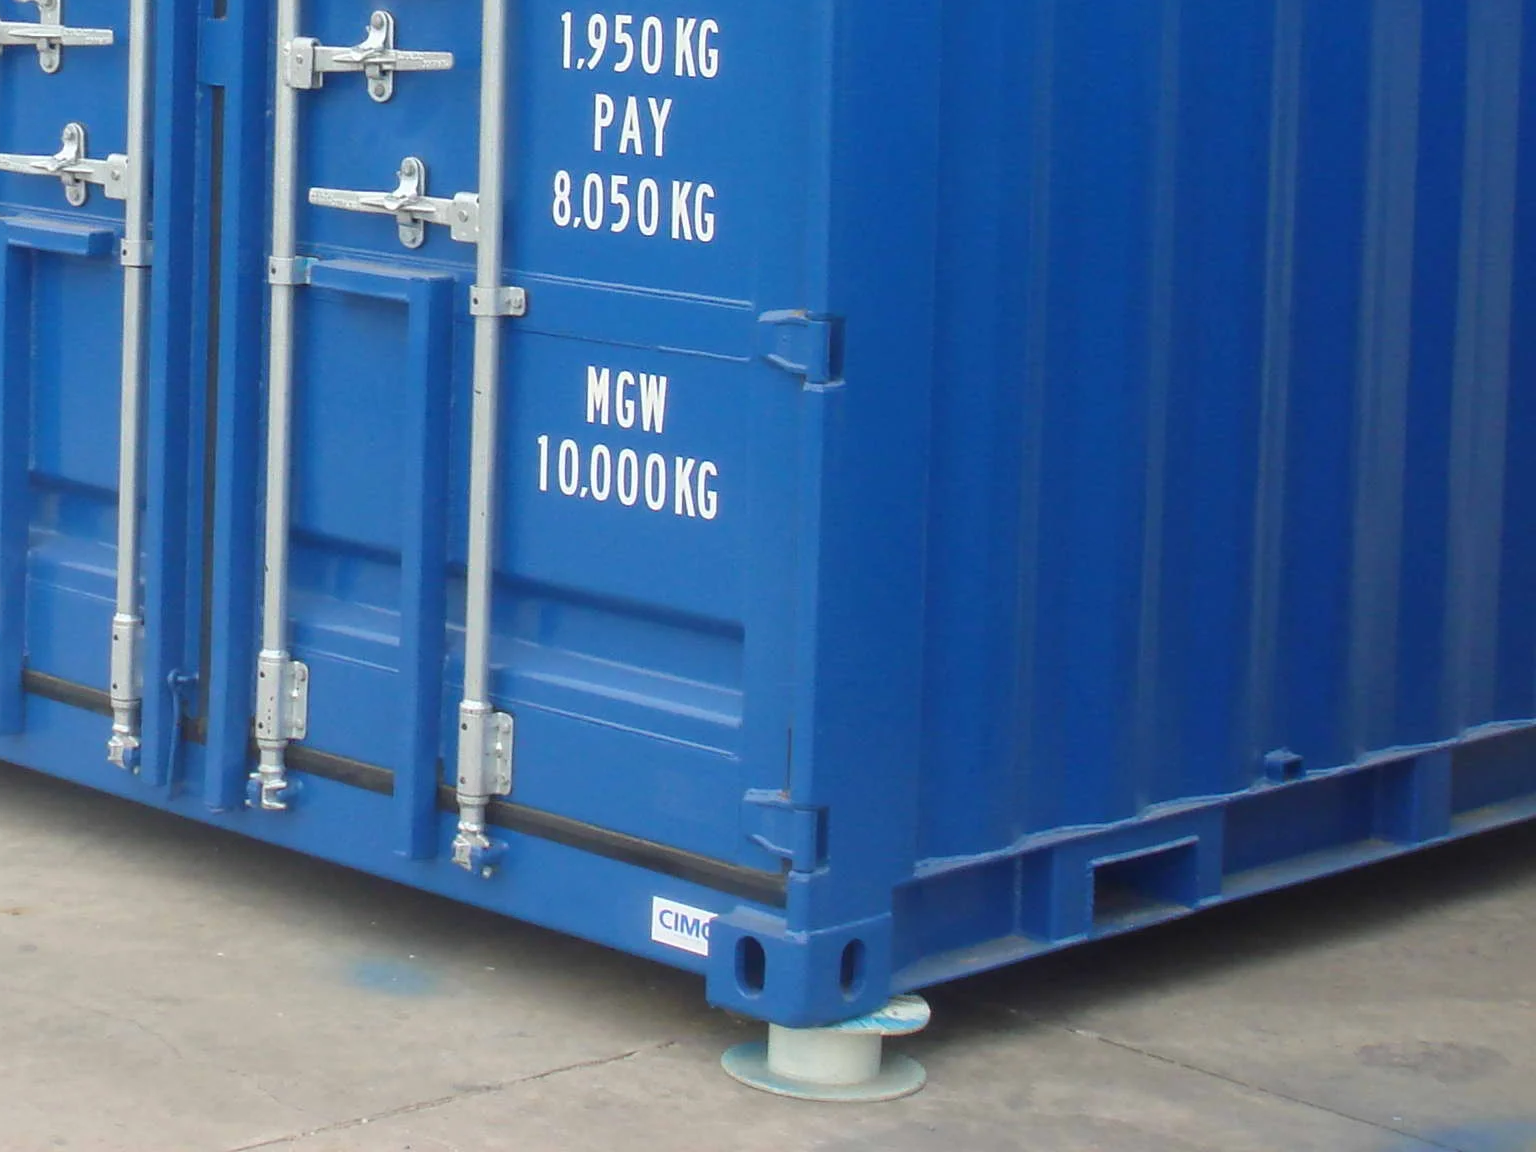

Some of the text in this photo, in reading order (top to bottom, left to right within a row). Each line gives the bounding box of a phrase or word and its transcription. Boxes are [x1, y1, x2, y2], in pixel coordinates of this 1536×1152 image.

[675, 17, 719, 78] KG
[594, 93, 673, 157] PAY
[671, 180, 715, 242] KG
[586, 365, 667, 434] MGW
